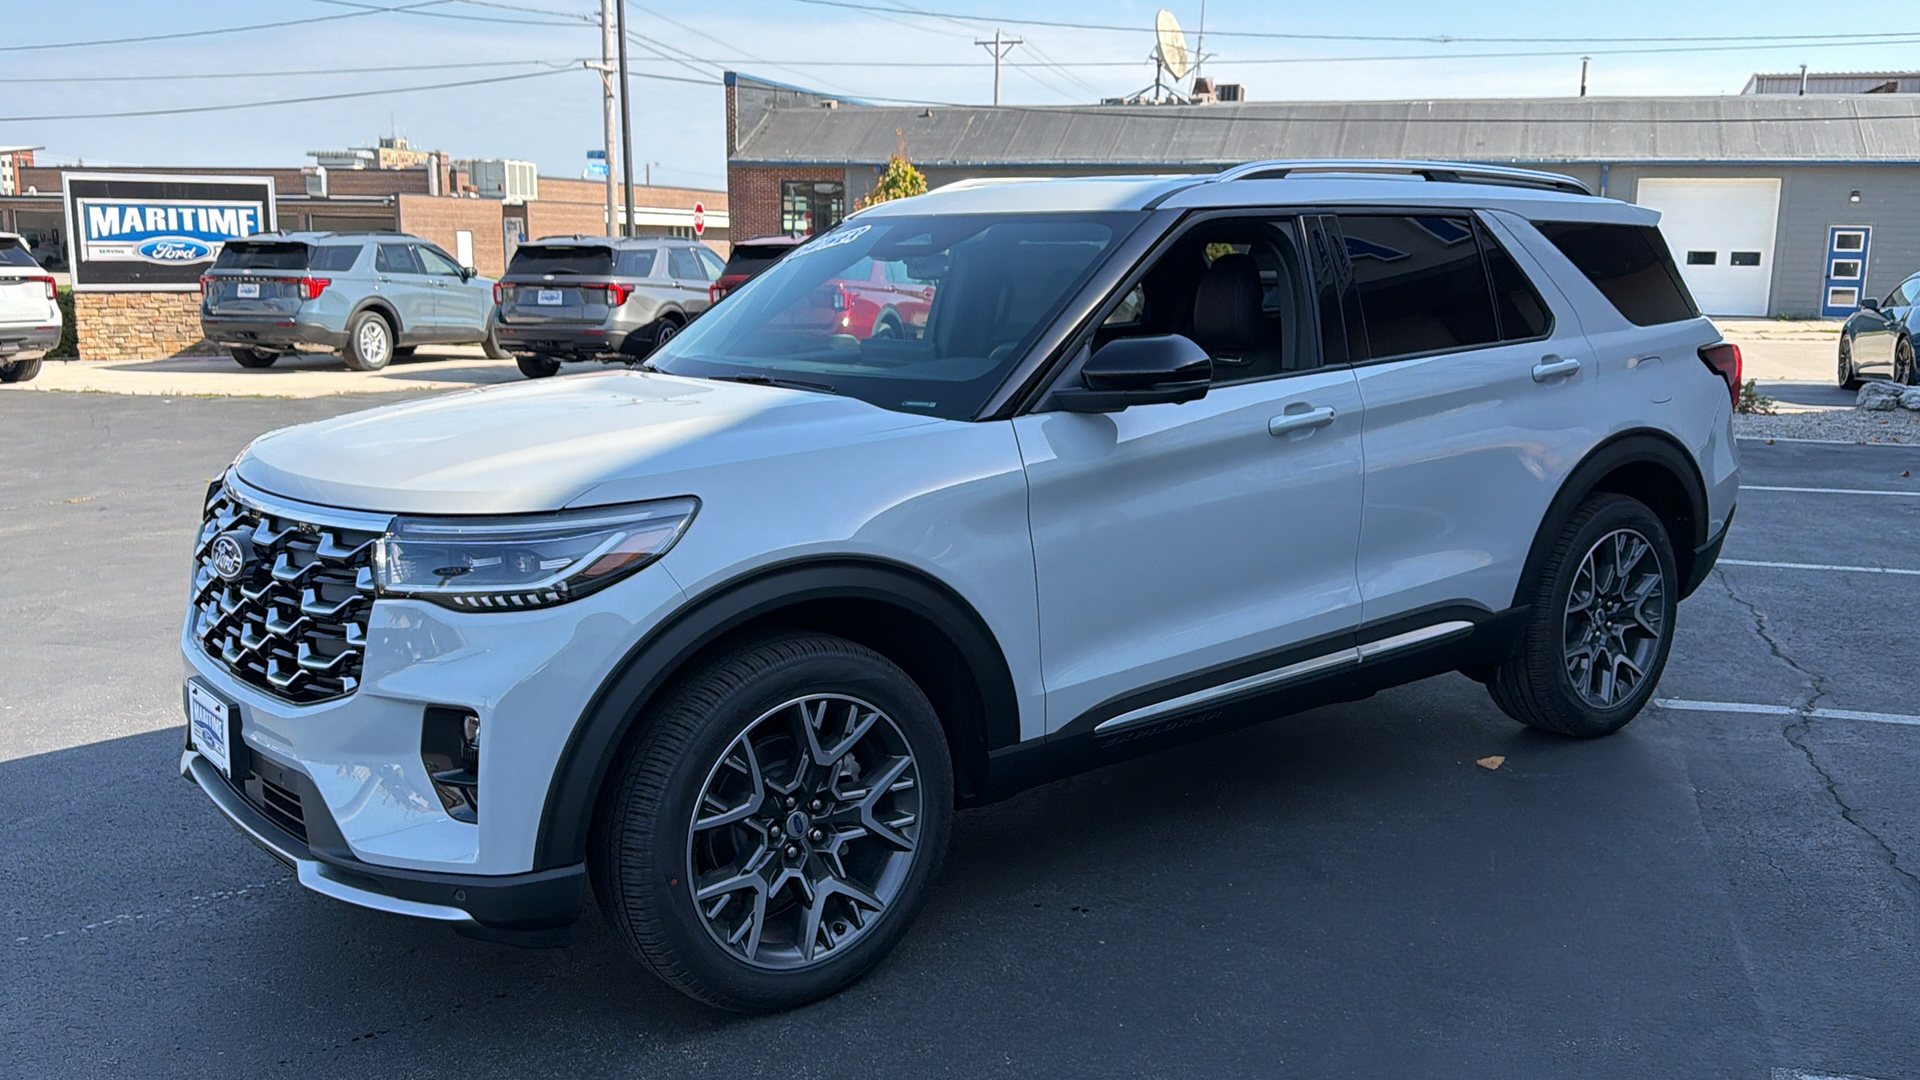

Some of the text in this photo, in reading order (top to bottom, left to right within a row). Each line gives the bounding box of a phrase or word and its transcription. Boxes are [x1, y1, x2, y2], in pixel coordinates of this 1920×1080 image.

[89, 206, 255, 239] MARITIME
[152, 241, 197, 260] Ford
[214, 540, 237, 573] Ford
